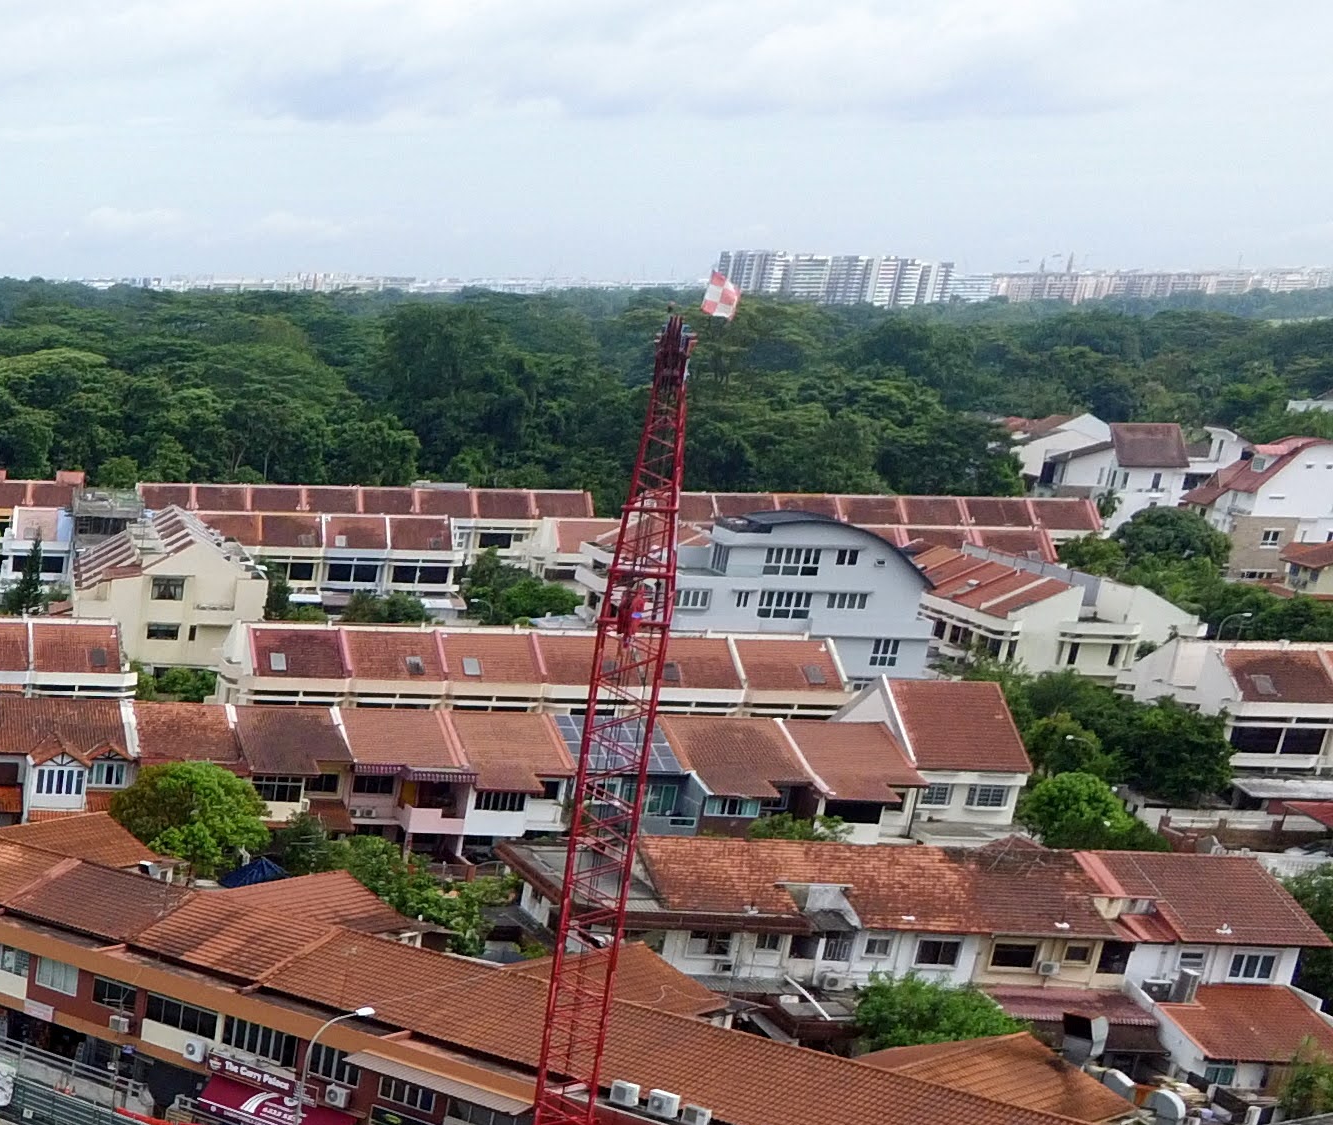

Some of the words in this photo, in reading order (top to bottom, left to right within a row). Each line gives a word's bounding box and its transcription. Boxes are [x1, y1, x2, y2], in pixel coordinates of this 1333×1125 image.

[225, 1060, 239, 1073] The
[240, 1066, 262, 1082] Curry
[263, 1074, 290, 1090] Palace
